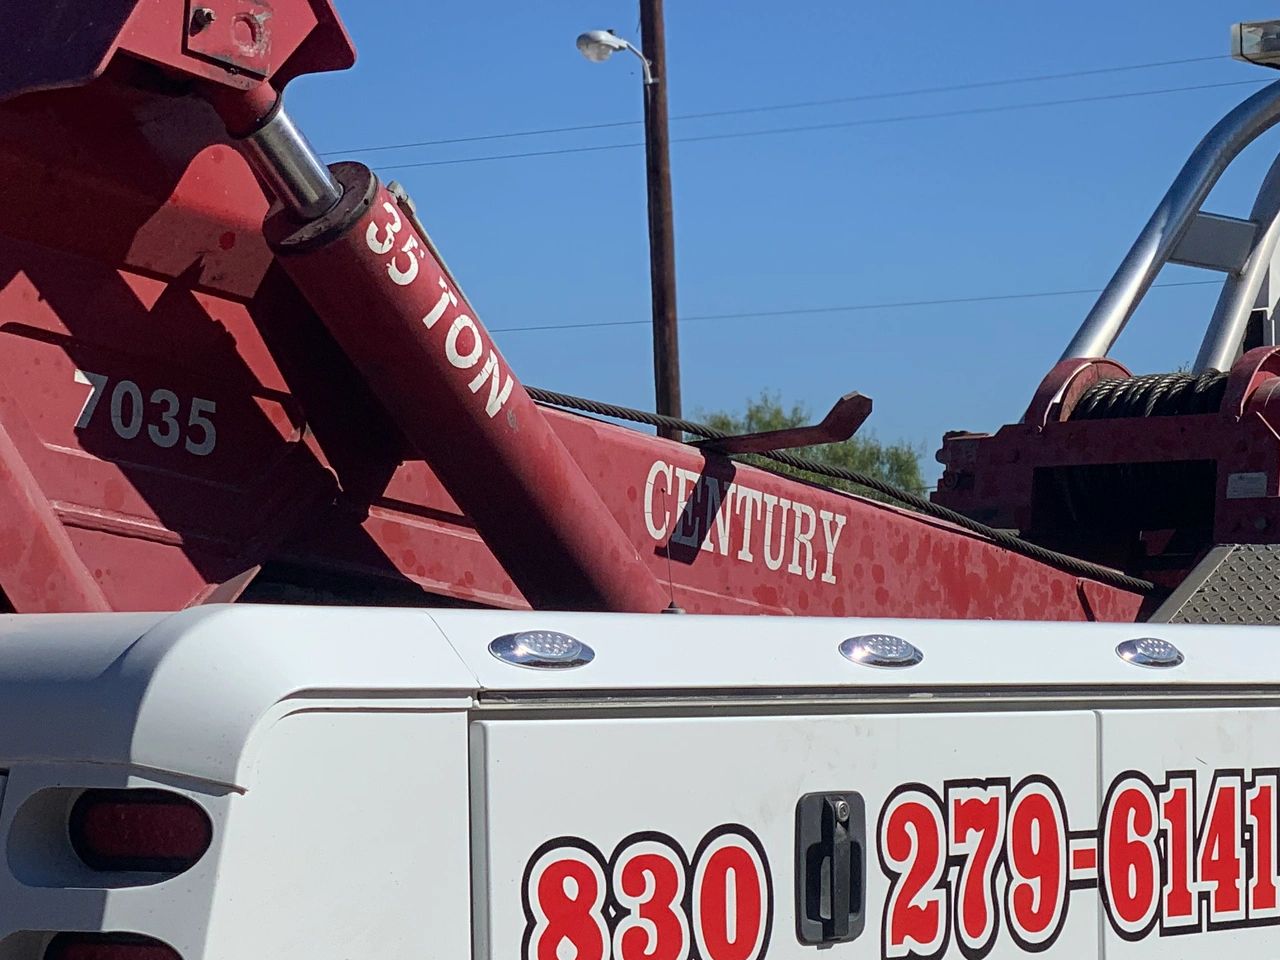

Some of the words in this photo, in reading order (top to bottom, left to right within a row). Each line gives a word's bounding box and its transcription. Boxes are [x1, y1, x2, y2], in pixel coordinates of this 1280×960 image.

[366, 201, 425, 286] 35
[423, 276, 515, 418] TON
[74, 368, 217, 456] 7035
[644, 460, 847, 585] CENTURY
